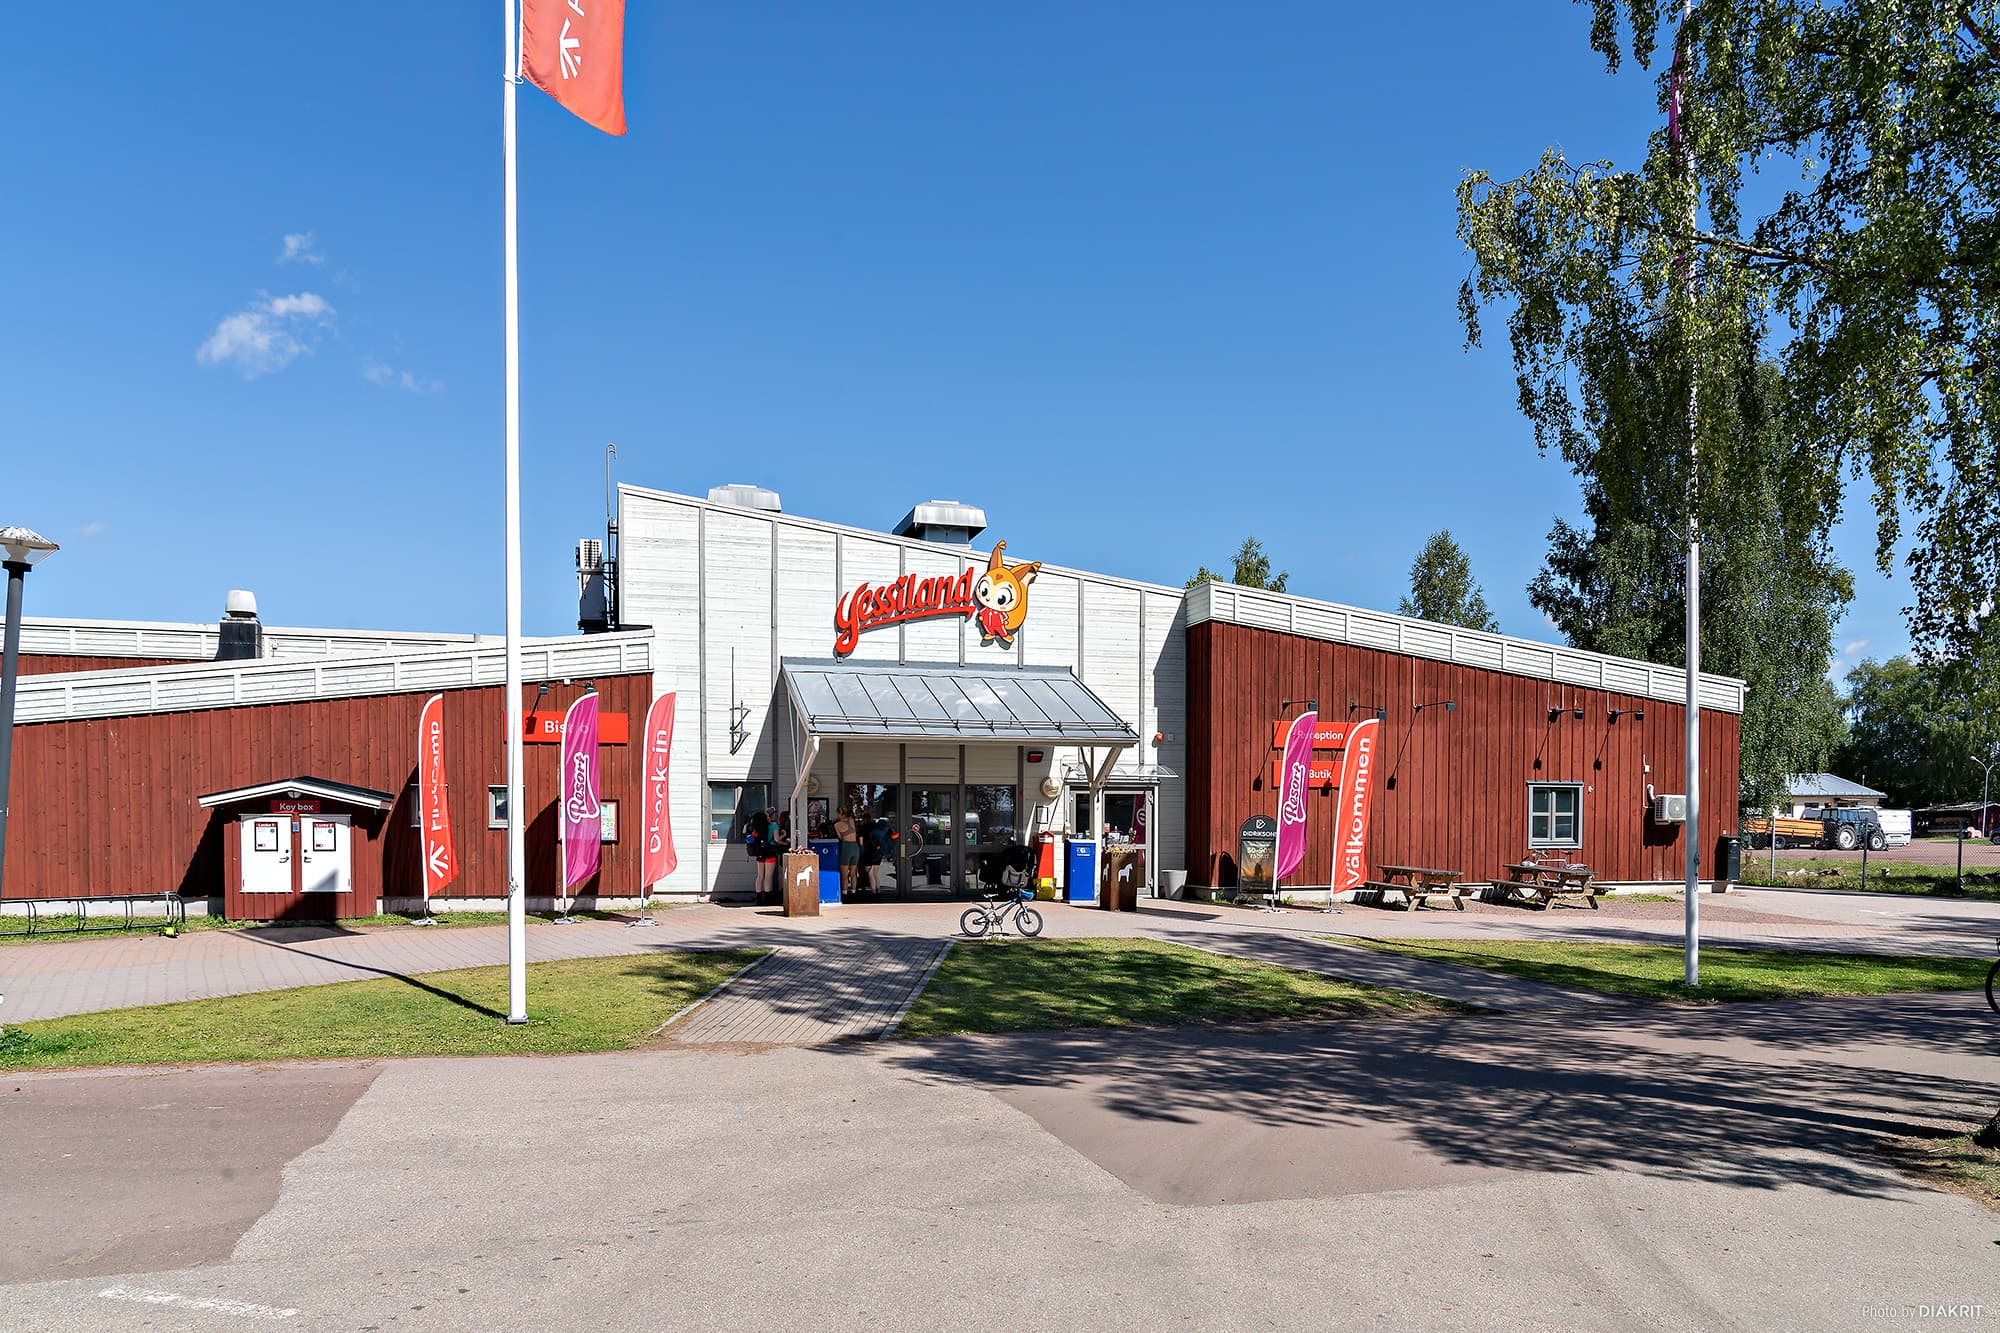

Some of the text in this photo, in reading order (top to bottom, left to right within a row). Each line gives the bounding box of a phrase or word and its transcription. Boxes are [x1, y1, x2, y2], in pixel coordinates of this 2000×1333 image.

[834, 567, 977, 654] Yessiland
[279, 803, 314, 812] Key box
[567, 752, 600, 824] Resort
[1283, 761, 1306, 825] Resort
[1309, 769, 1332, 779] Butik
[1346, 737, 1371, 886] Välkommen
